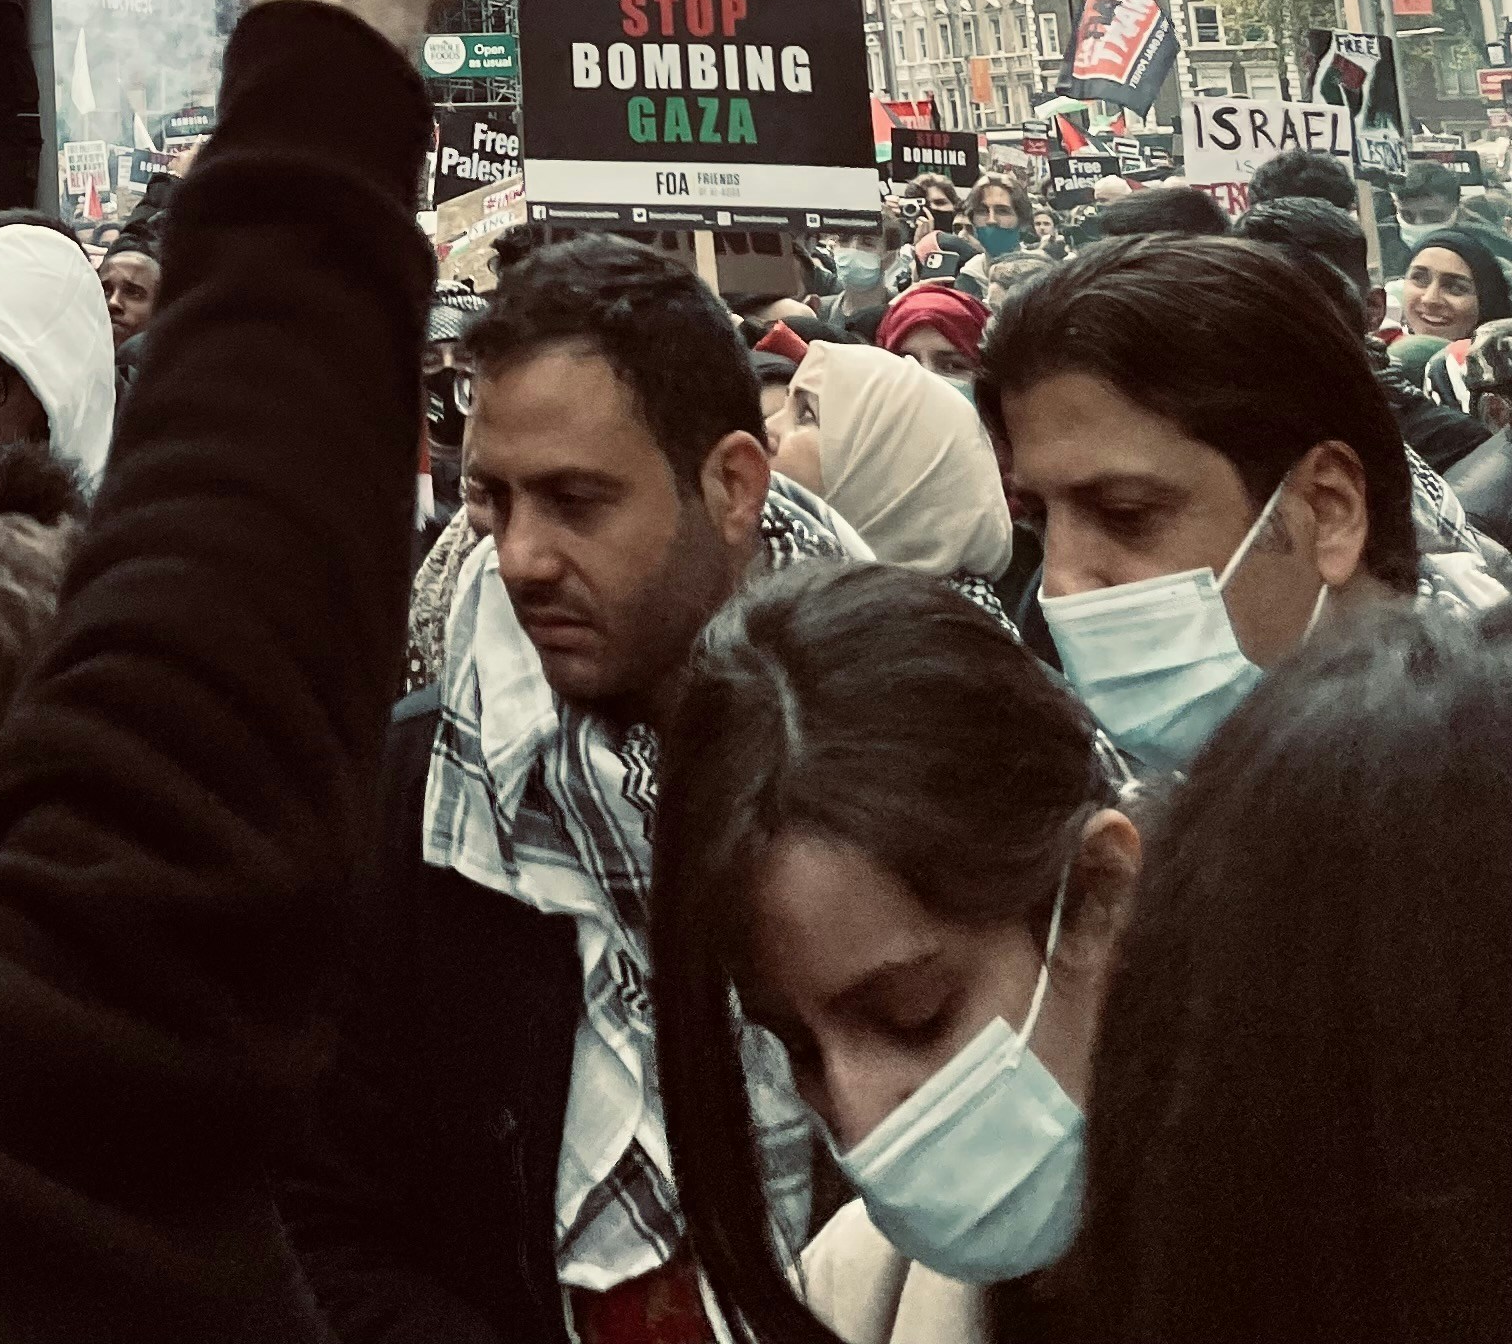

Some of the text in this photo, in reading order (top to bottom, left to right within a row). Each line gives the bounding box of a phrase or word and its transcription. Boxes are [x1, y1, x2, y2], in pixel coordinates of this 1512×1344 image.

[474, 43, 506, 58] Open
[483, 56, 513, 68] usual
[572, 42, 814, 93] BOMBING
[627, 95, 758, 145] GAZA
[1193, 103, 1351, 157] ISRAEL
[473, 122, 520, 157] Free
[903, 146, 967, 166] BOMBING
[1068, 159, 1102, 174] Free
[655, 171, 690, 196] FOA
[697, 172, 740, 186] FRIENDS
